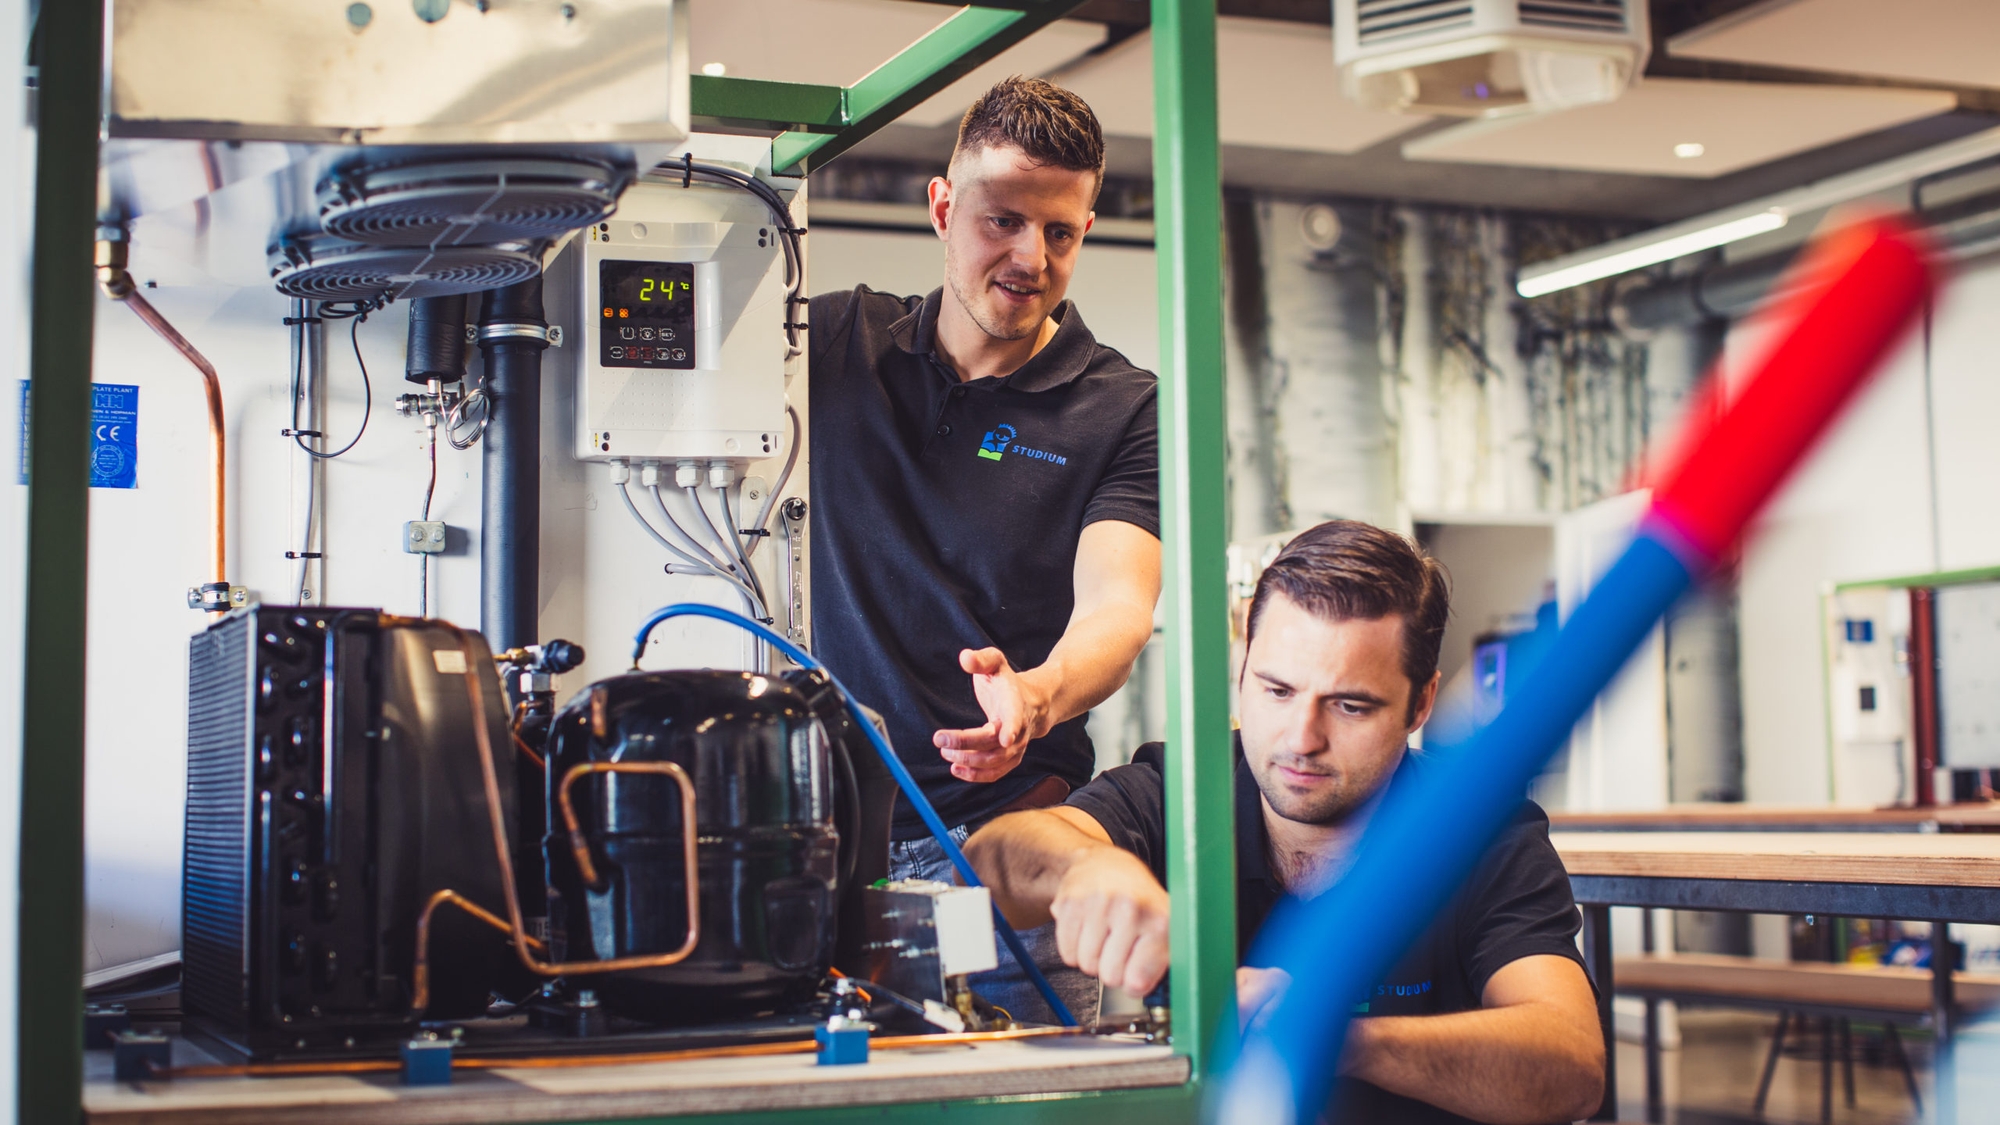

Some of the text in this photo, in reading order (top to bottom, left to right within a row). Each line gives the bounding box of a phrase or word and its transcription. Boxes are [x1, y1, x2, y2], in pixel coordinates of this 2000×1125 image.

[640, 279, 674, 301] 24
[97, 425, 120, 441] CE
[1012, 445, 1067, 466] STUDIUM
[1377, 981, 1431, 996] STUDUM
